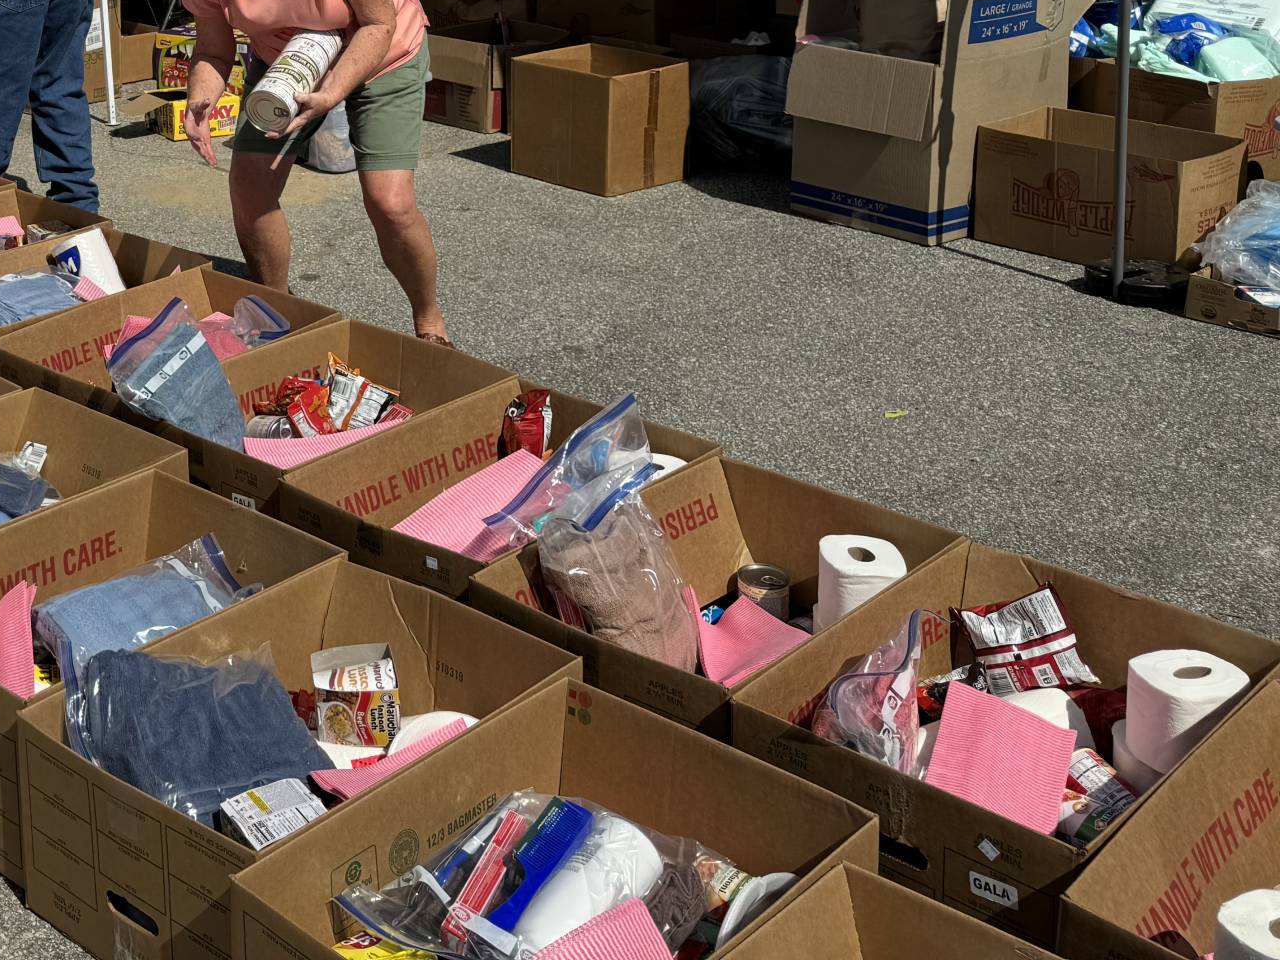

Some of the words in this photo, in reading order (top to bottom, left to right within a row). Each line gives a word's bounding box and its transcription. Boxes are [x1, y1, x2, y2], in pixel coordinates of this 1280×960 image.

[1011, 0, 1033, 12] GRANDE
[36, 343, 94, 373] ANDLE
[95, 328, 122, 357] WIT
[402, 453, 450, 492] WITH
[659, 493, 719, 541] PERIS
[63, 530, 123, 577] CARE.
[648, 679, 684, 700] APPLES
[370, 707, 378, 731] Lunch
[376, 704, 386, 733] Instant
[387, 700, 396, 742] Maruchan
[426, 829, 445, 849] 12/3
[447, 793, 498, 835] BAGMASTER
[1191, 811, 1239, 885] WITH
[973, 877, 1011, 902] GALA
